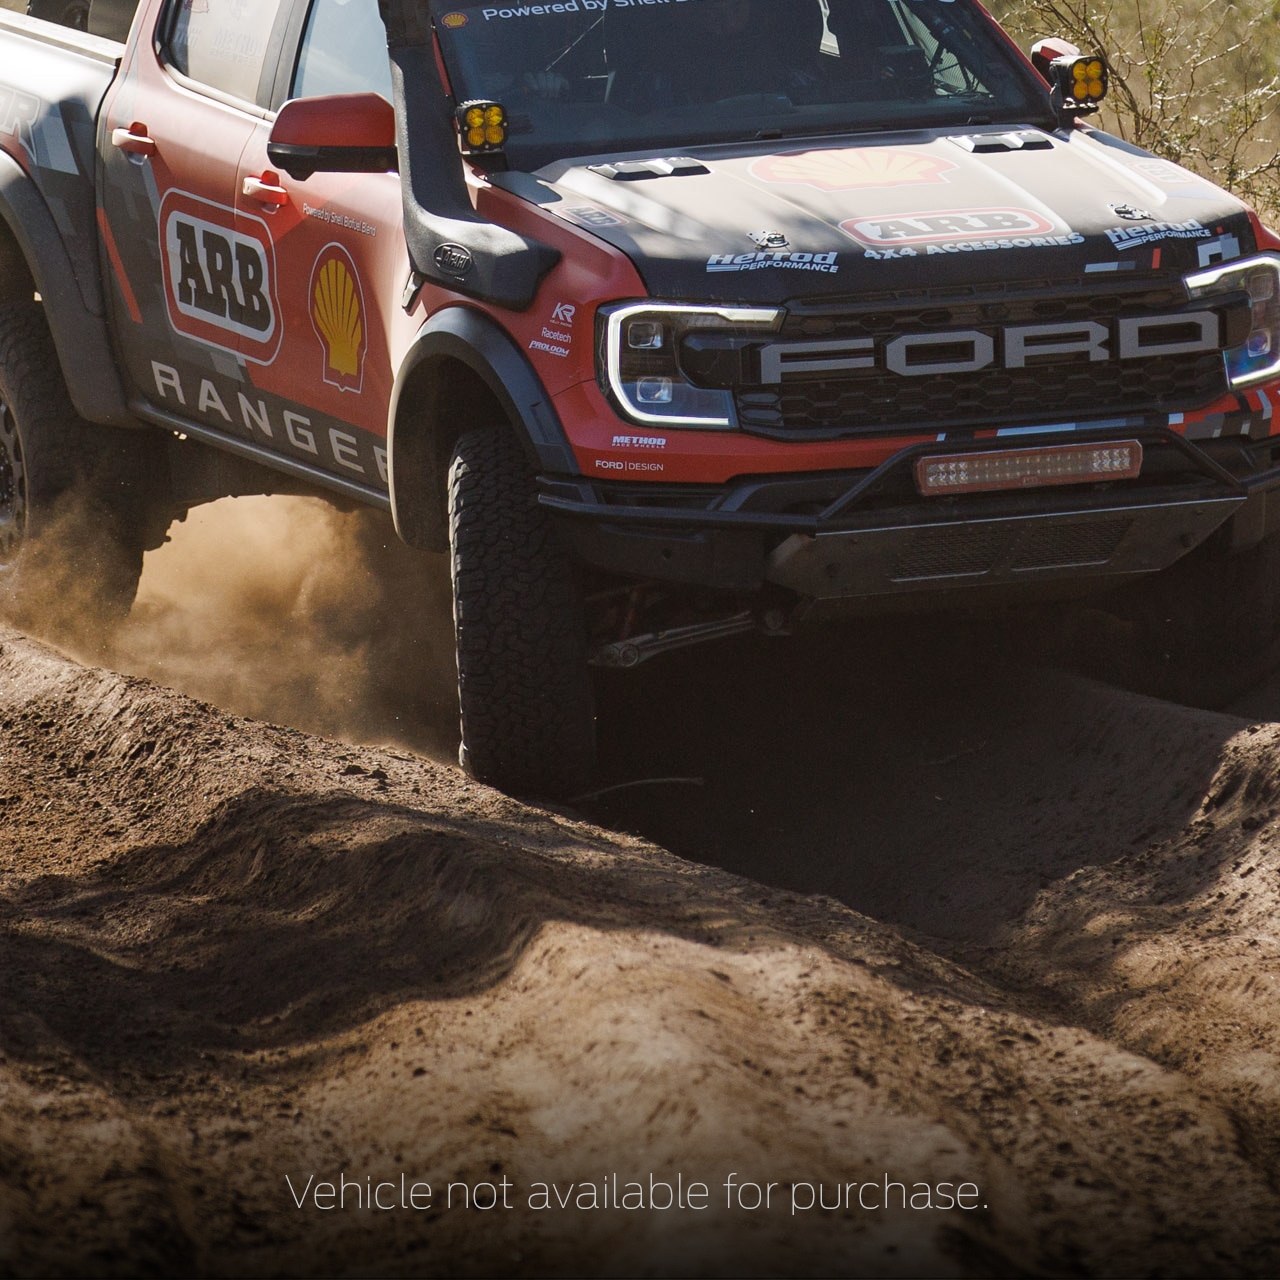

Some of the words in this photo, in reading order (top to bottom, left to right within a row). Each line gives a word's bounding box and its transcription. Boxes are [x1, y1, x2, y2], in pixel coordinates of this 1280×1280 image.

[303, 202, 324, 219] Powered
[331, 212, 344, 226] Shell
[870, 212, 1032, 239] ARB
[1103, 220, 1204, 243] Herrod
[926, 232, 1086, 255] ACCESSORIES
[1141, 229, 1212, 244] PERFORMANCE
[706, 251, 839, 265] Herrod
[740, 260, 839, 274] PERFORMANCE
[176, 220, 272, 332] ARB
[551, 302, 576, 323] KR
[541, 326, 572, 344] Racetech
[760, 311, 1219, 385] FORD
[611, 435, 667, 446] METHOD
[595, 460, 624, 470] FORD
[628, 463, 664, 471] DESIGN
